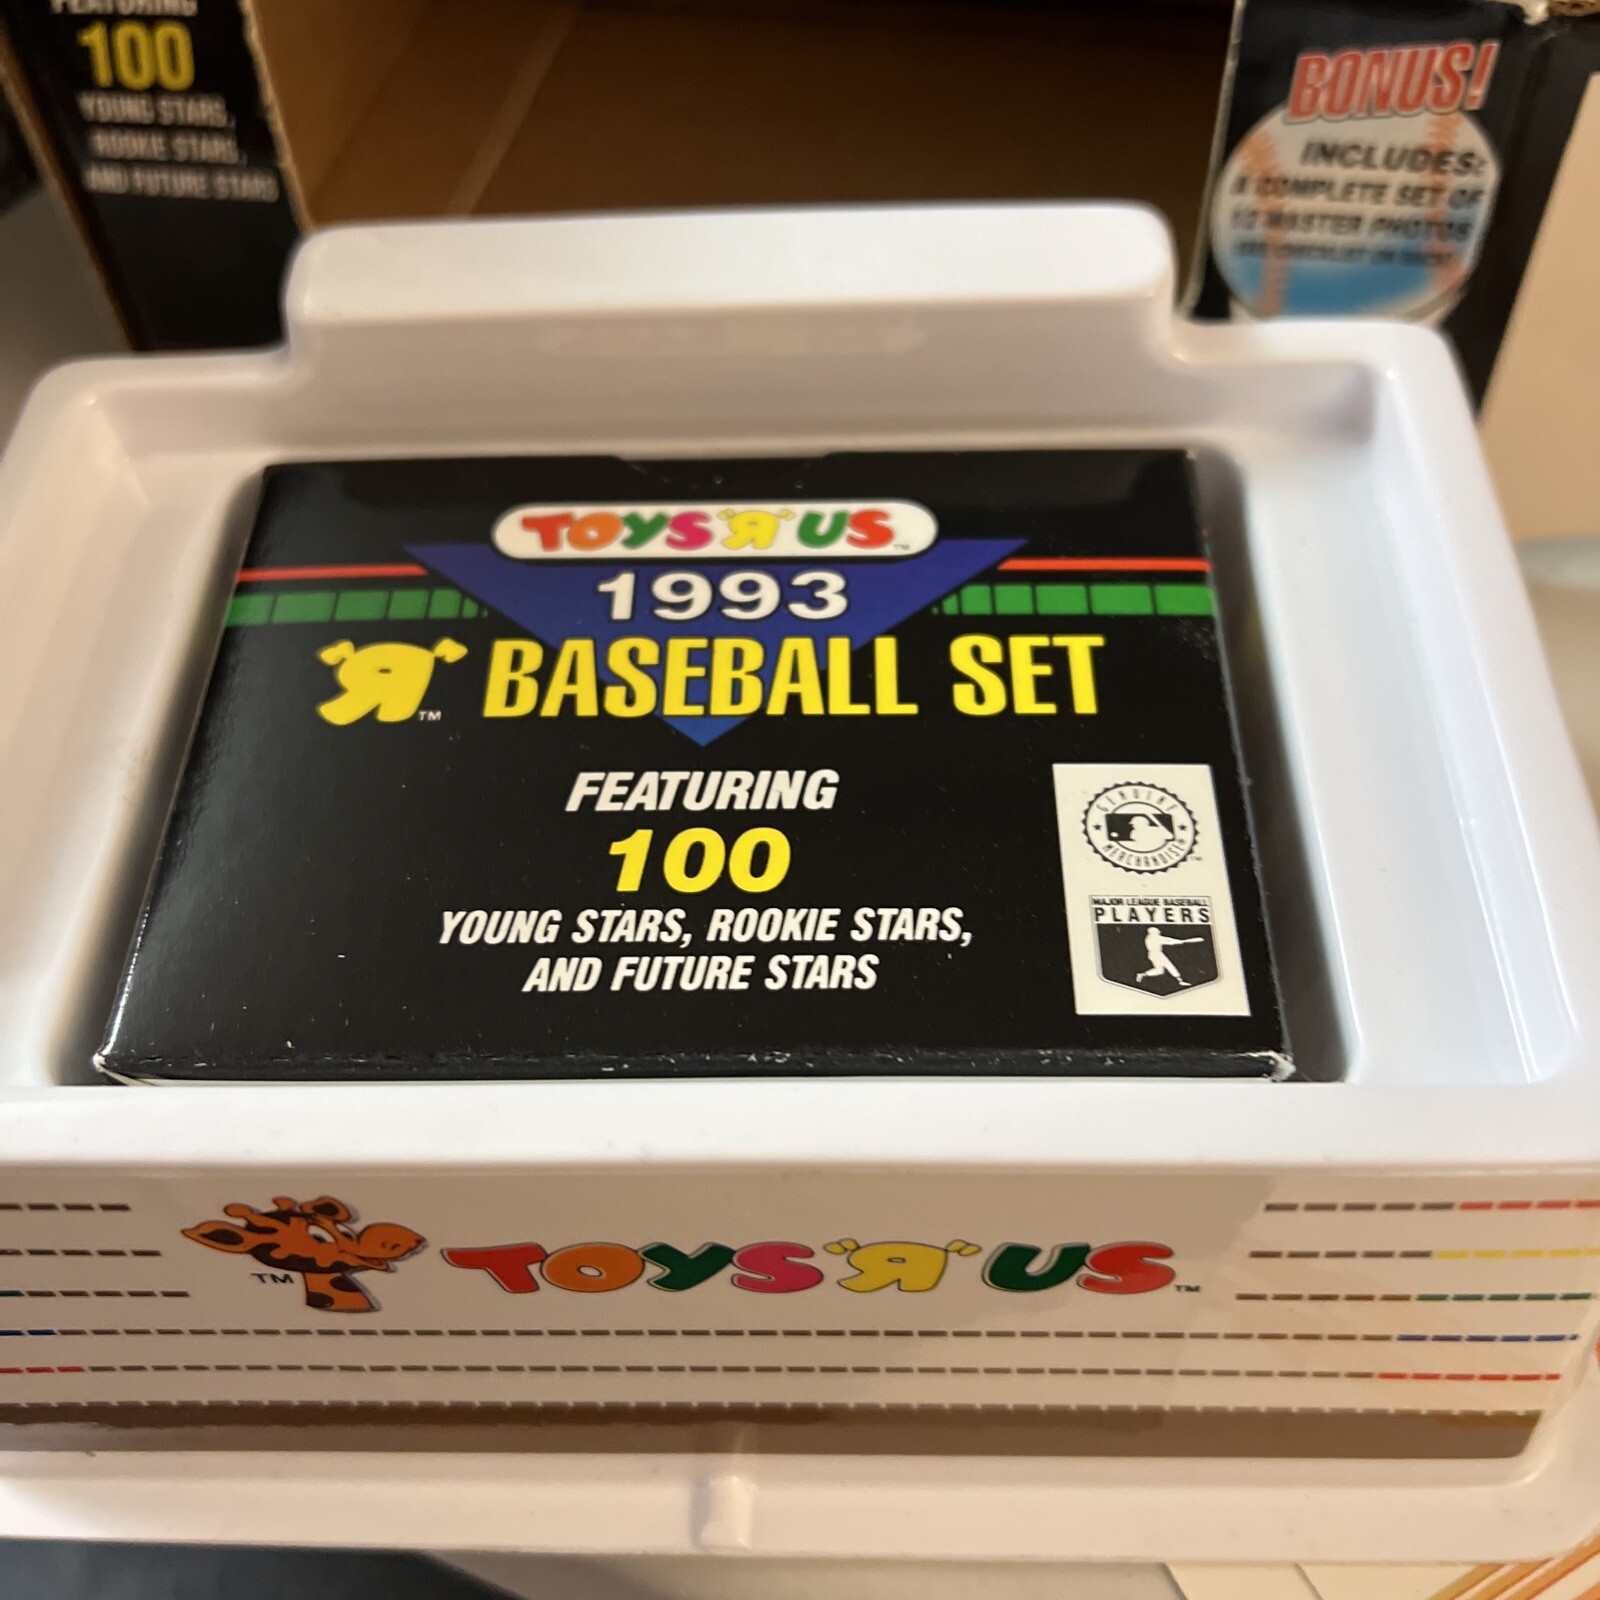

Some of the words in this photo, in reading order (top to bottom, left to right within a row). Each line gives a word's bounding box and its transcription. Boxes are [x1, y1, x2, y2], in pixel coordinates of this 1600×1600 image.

[78, 20, 195, 90] 100
[1285, 40, 1499, 125] BONUS!
[1301, 140, 1487, 176] INCLUDES:
[522, 511, 713, 552] TOYS
[797, 508, 894, 549] US
[597, 569, 848, 620] 1993
[483, 635, 918, 718] BASEBALL
[949, 634, 1105, 717] SET
[565, 769, 840, 812] FEATURING
[608, 826, 791, 893] 100
[1092, 898, 1124, 906] MAJOR
[1127, 898, 1160, 906] LEAGUE
[1163, 898, 1208, 907] BASEBALL
[1094, 907, 1210, 922] PLAYERS
[439, 909, 562, 945] YOUNG
[571, 908, 693, 948] STARS,
[706, 907, 841, 943] ROOKIE
[849, 906, 973, 947] STARS,
[522, 957, 603, 993] AND
[609, 955, 756, 992] FUTURE
[764, 953, 880, 991] STARS
[441, 1241, 824, 1294] TOYS
[981, 1240, 1176, 1294] US
